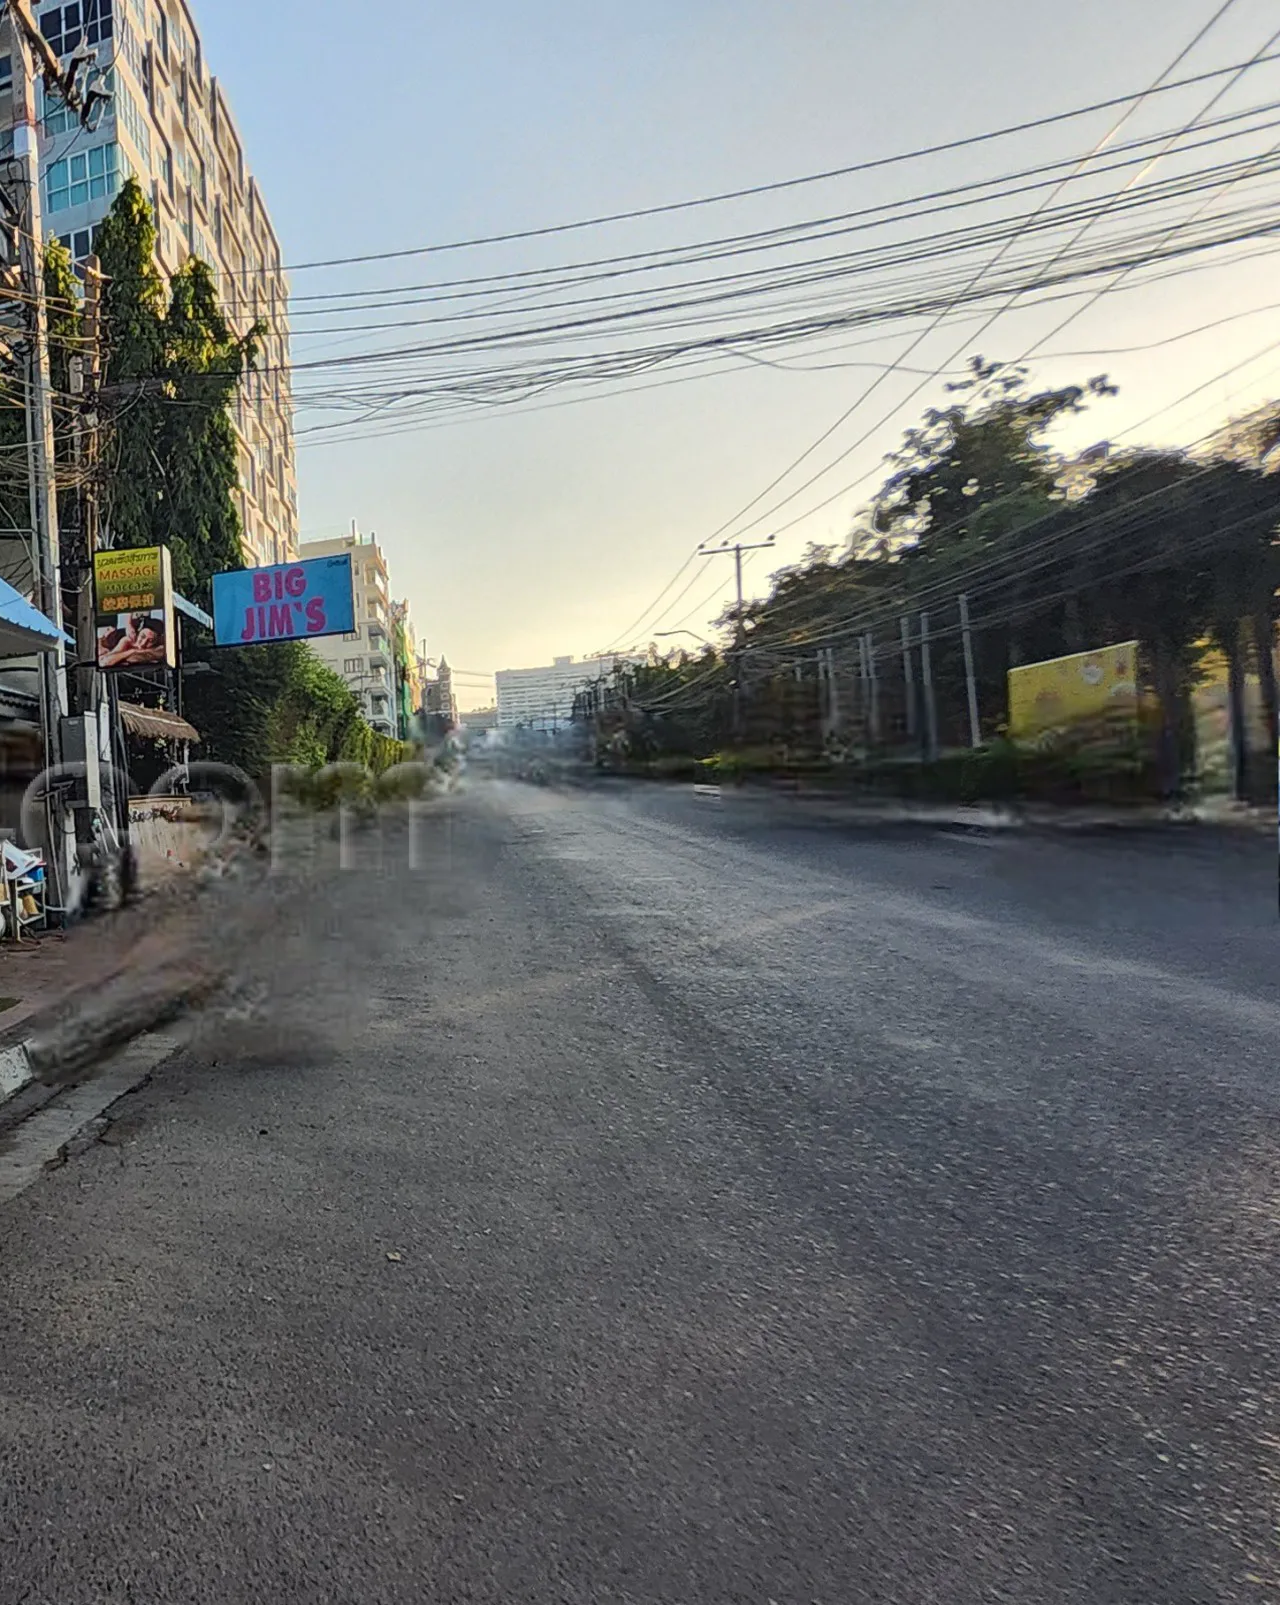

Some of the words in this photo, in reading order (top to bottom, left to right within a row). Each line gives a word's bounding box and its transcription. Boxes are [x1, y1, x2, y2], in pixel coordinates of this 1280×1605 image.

[99, 565, 157, 581] MASSAGE
[253, 567, 307, 603] BIG
[241, 596, 326, 640] JIM'S
